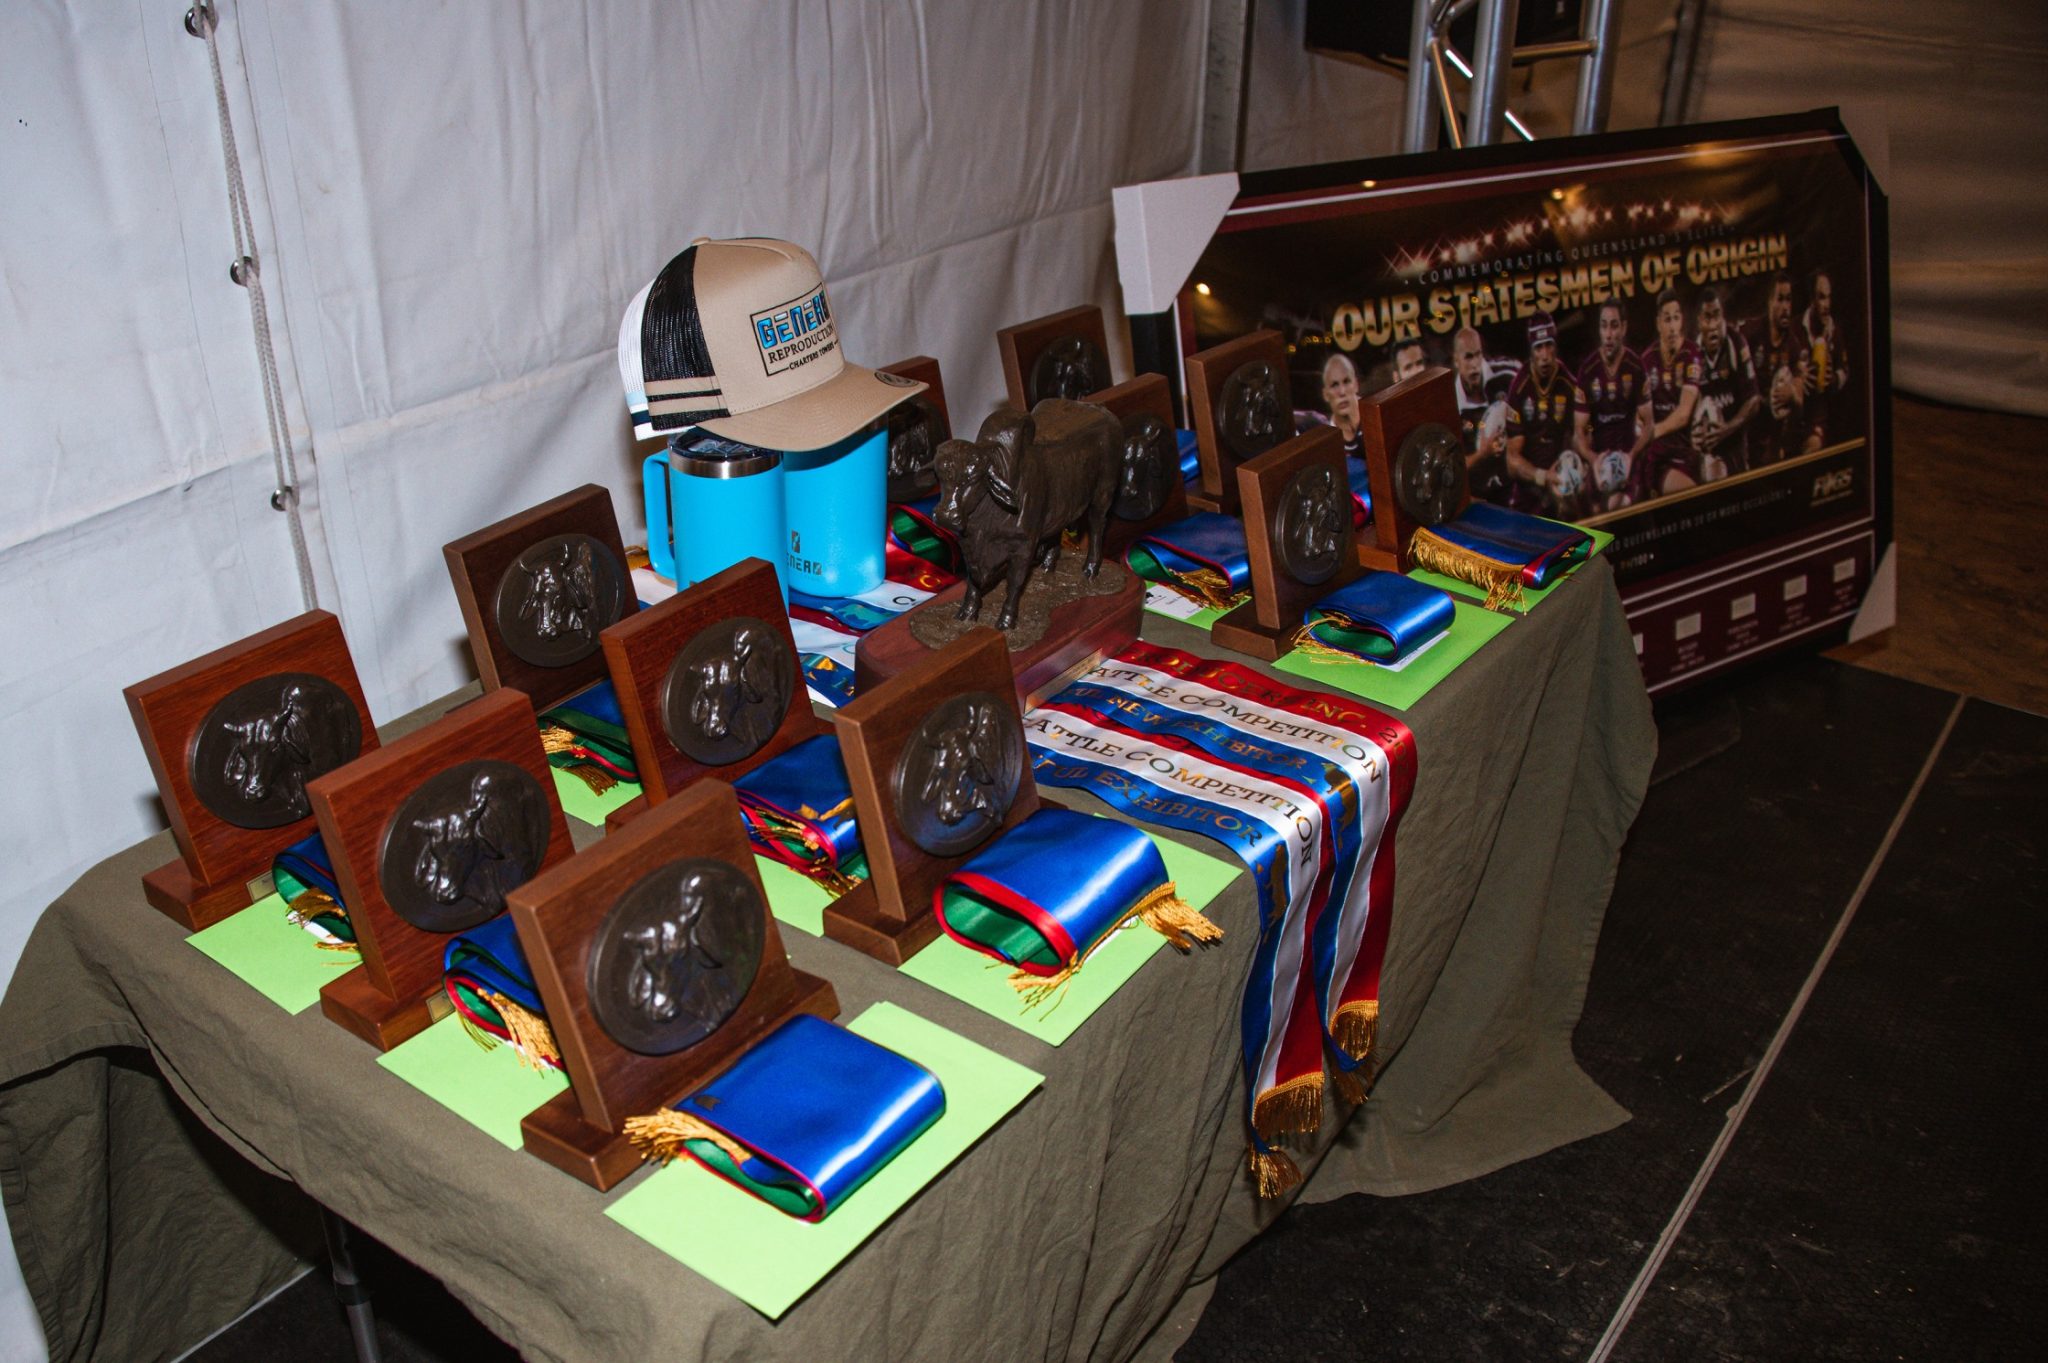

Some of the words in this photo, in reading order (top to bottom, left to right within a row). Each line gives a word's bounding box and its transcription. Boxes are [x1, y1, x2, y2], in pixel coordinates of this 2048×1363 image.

[1332, 292, 1422, 352] OUR
[1427, 253, 1636, 335] STATESMEN
[1640, 244, 1683, 295] OF
[1686, 231, 1790, 287] ORIGIN
[1418, 249, 1564, 286] COMMEMORATING
[1688, 225, 1724, 241] ELITE
[789, 351, 819, 370] CHARTERS
[1090, 667, 1177, 699] ATTLE
[1179, 693, 1383, 784] COMPETITION
[1106, 694, 1163, 725] NEW
[1171, 719, 1308, 770] EXHIBITOR
[1300, 700, 1367, 729] INC.
[1095, 770, 1263, 847] EXHIBITOR
[1126, 750, 1313, 867] COMPETITION
